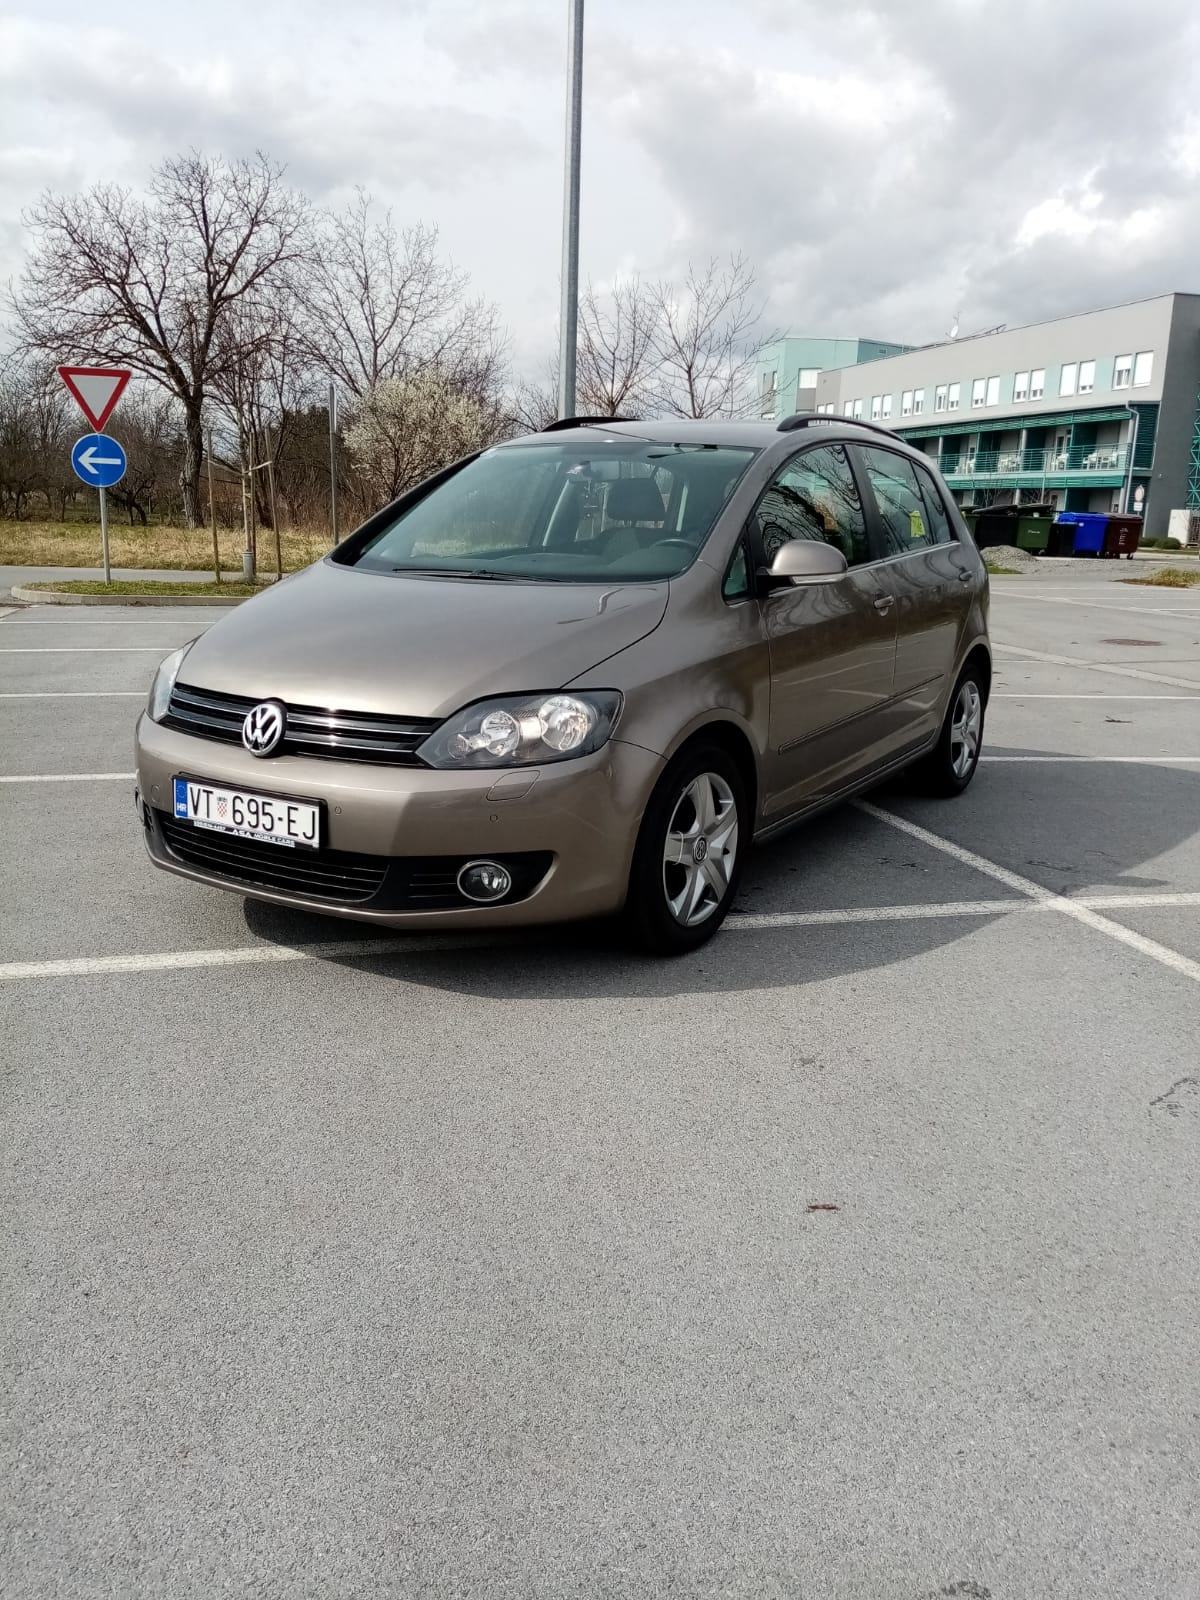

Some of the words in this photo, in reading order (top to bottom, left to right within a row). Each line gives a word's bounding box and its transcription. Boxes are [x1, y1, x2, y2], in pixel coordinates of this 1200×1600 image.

[176, 802, 187, 812] HR
[190, 786, 214, 818] VT
[232, 795, 316, 840] 695-EJ
[232, 829, 252, 838] ASA
